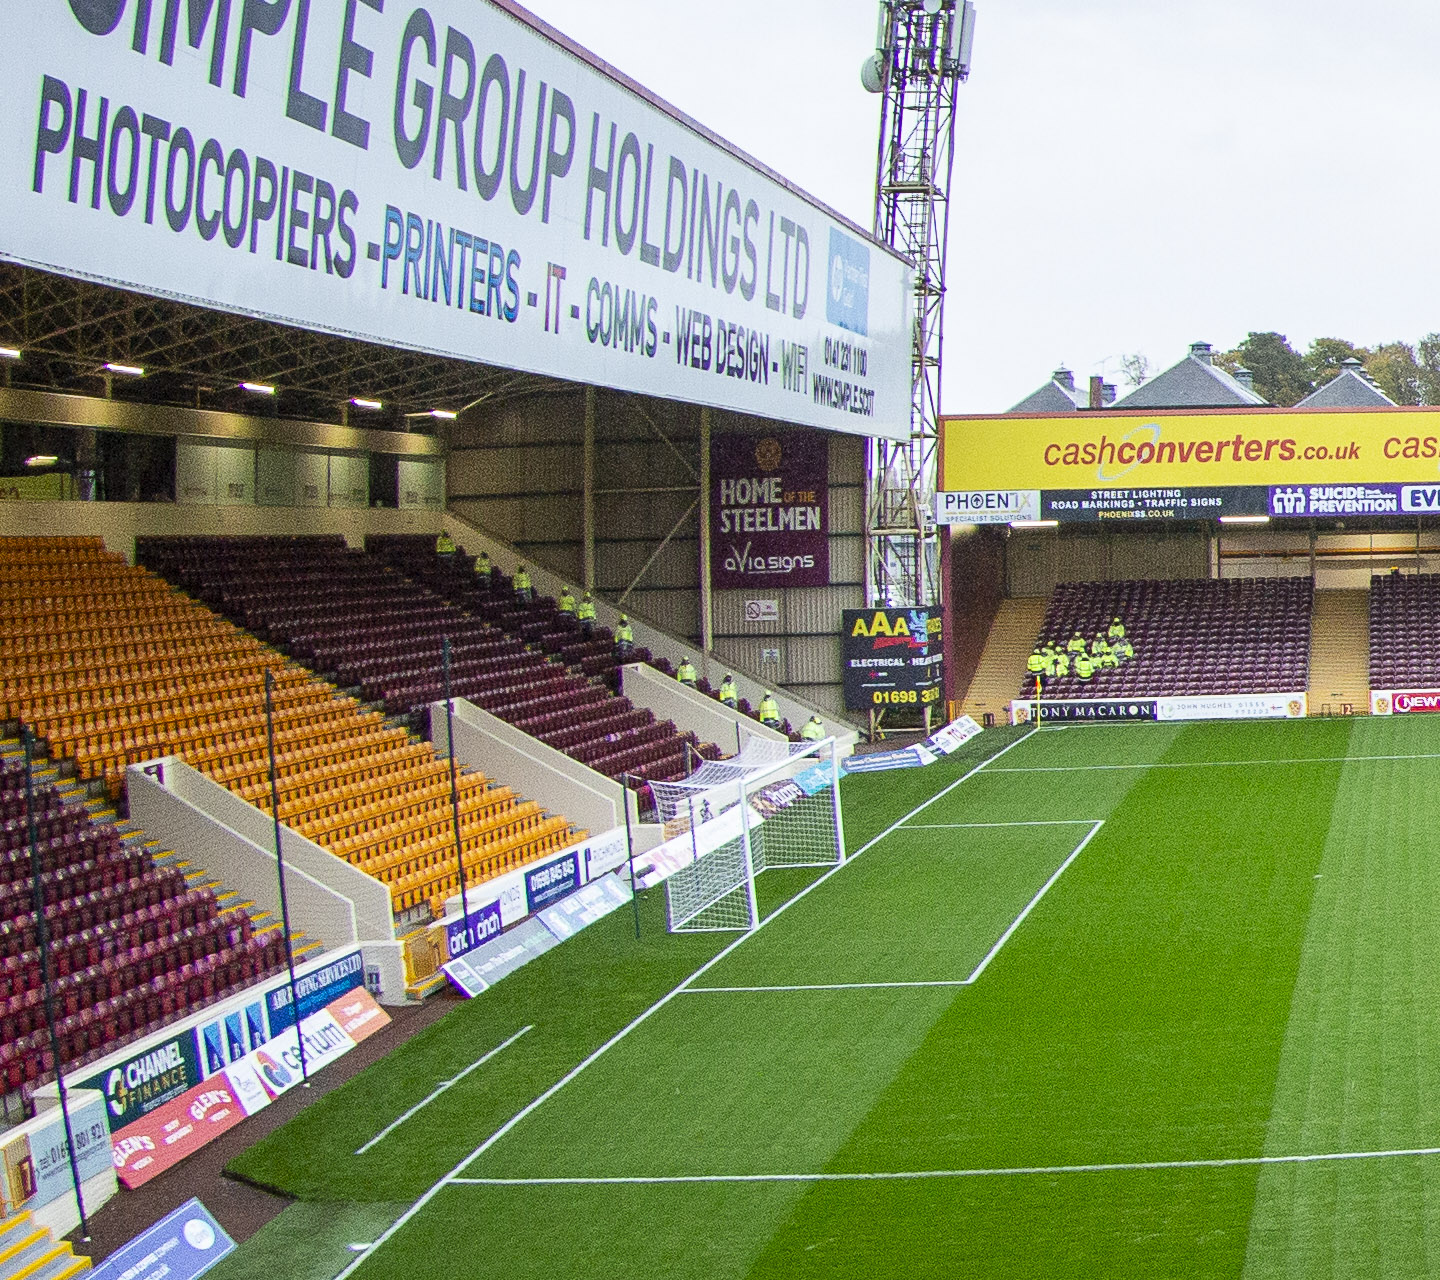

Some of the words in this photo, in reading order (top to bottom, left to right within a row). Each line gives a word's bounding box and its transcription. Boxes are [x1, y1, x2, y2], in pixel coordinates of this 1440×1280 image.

[393, 7, 577, 225] GROUP
[583, 111, 760, 302] HOLDINGS
[765, 209, 810, 321] LTD
[31, 73, 360, 280] PHOTOCOPIERS
[544, 261, 567, 335] IT
[585, 276, 658, 358] COMMS
[676, 304, 713, 372] WEB
[715, 317, 770, 386] DESIGN
[781, 338, 809, 395] WIFI
[1043, 434, 1362, 466] cashconverters.co.uk
[720, 477, 783, 506] HOME
[1051, 500, 1079, 510] ROAD
[1082, 499, 1135, 509] MARKINGS
[1145, 498, 1188, 508] TRAFFIC
[1190, 497, 1223, 507] SIGNS
[1091, 490, 1130, 500] STREET
[1132, 489, 1181, 499] LIGHTING
[1309, 486, 1365, 500] SUICIDE
[720, 505, 821, 533] STEELMEN
[1309, 499, 1397, 513] PREVENTION
[851, 611, 911, 637] AAA
[850, 657, 905, 667] ELECTRICAL
[872, 690, 918, 703] 01698
[1031, 706, 1070, 718] TONY
[1075, 704, 1158, 717] MACARONI
[126, 1041, 185, 1089] CHANNEL
[128, 1065, 187, 1109] FINANCE
[189, 1089, 232, 1121] GLEN'S
[111, 1135, 156, 1168] GLEN'S
